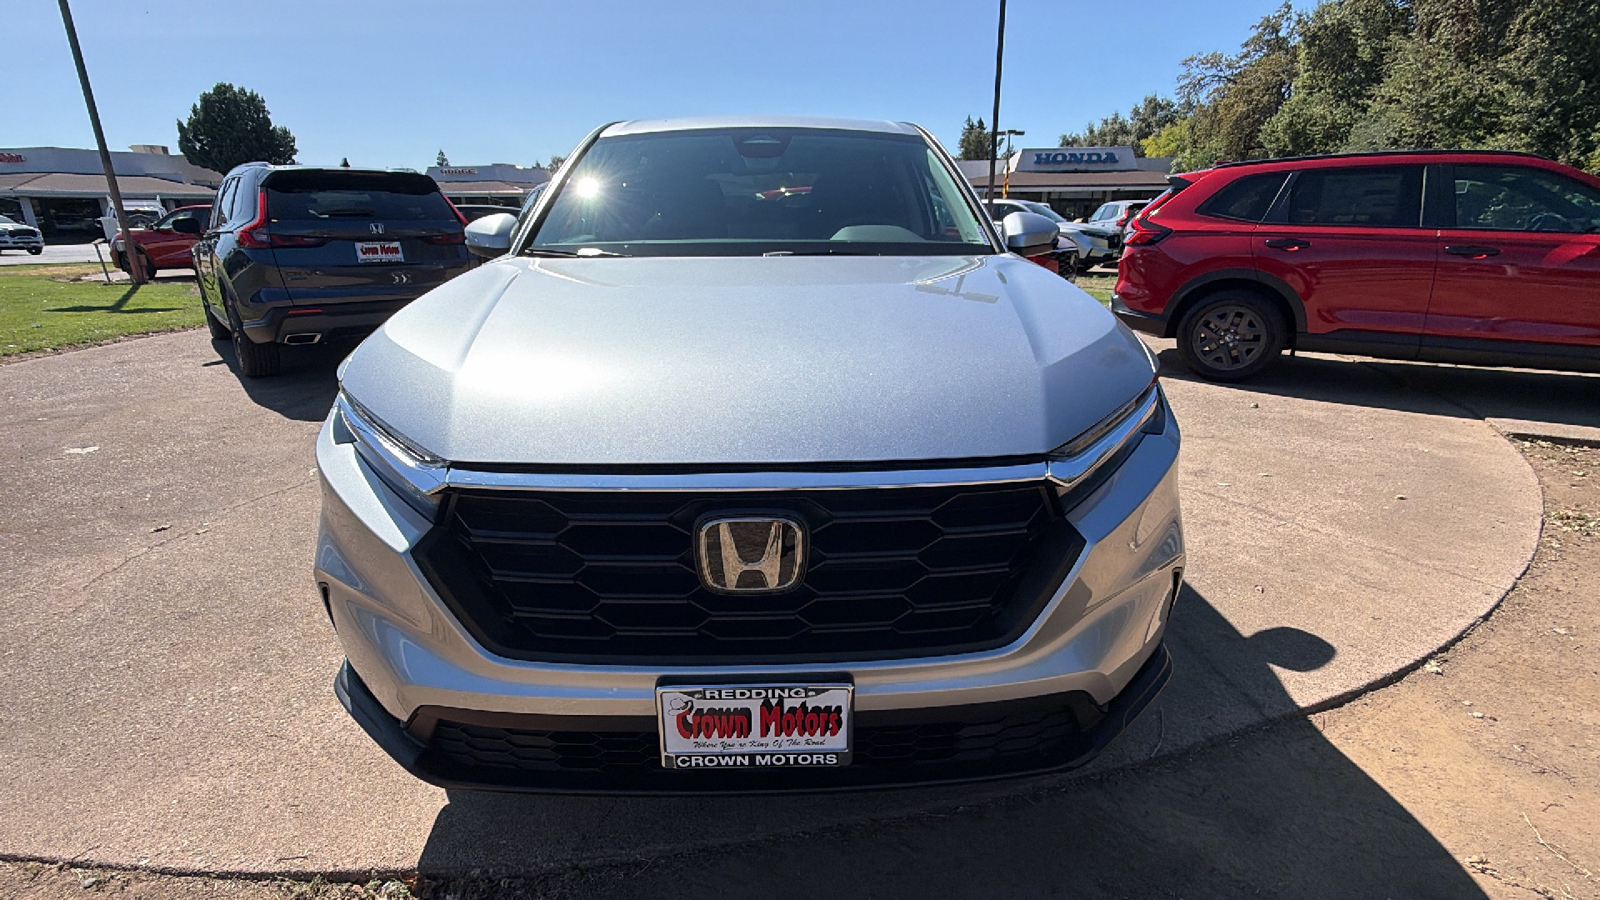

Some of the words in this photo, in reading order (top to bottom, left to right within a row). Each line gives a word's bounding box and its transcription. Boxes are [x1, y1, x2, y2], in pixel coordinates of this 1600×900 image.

[1034, 152, 1119, 165] HONDA
[704, 688, 806, 699] REDDING
[676, 703, 751, 740] Crown
[760, 700, 842, 739] Motors
[693, 741, 718, 749] Where
[749, 740, 769, 749] King
[773, 739, 783, 749] Of
[786, 739, 801, 747] The
[804, 739, 826, 747] Road
[676, 755, 749, 768] CROWN
[755, 754, 838, 766] MOTORS
